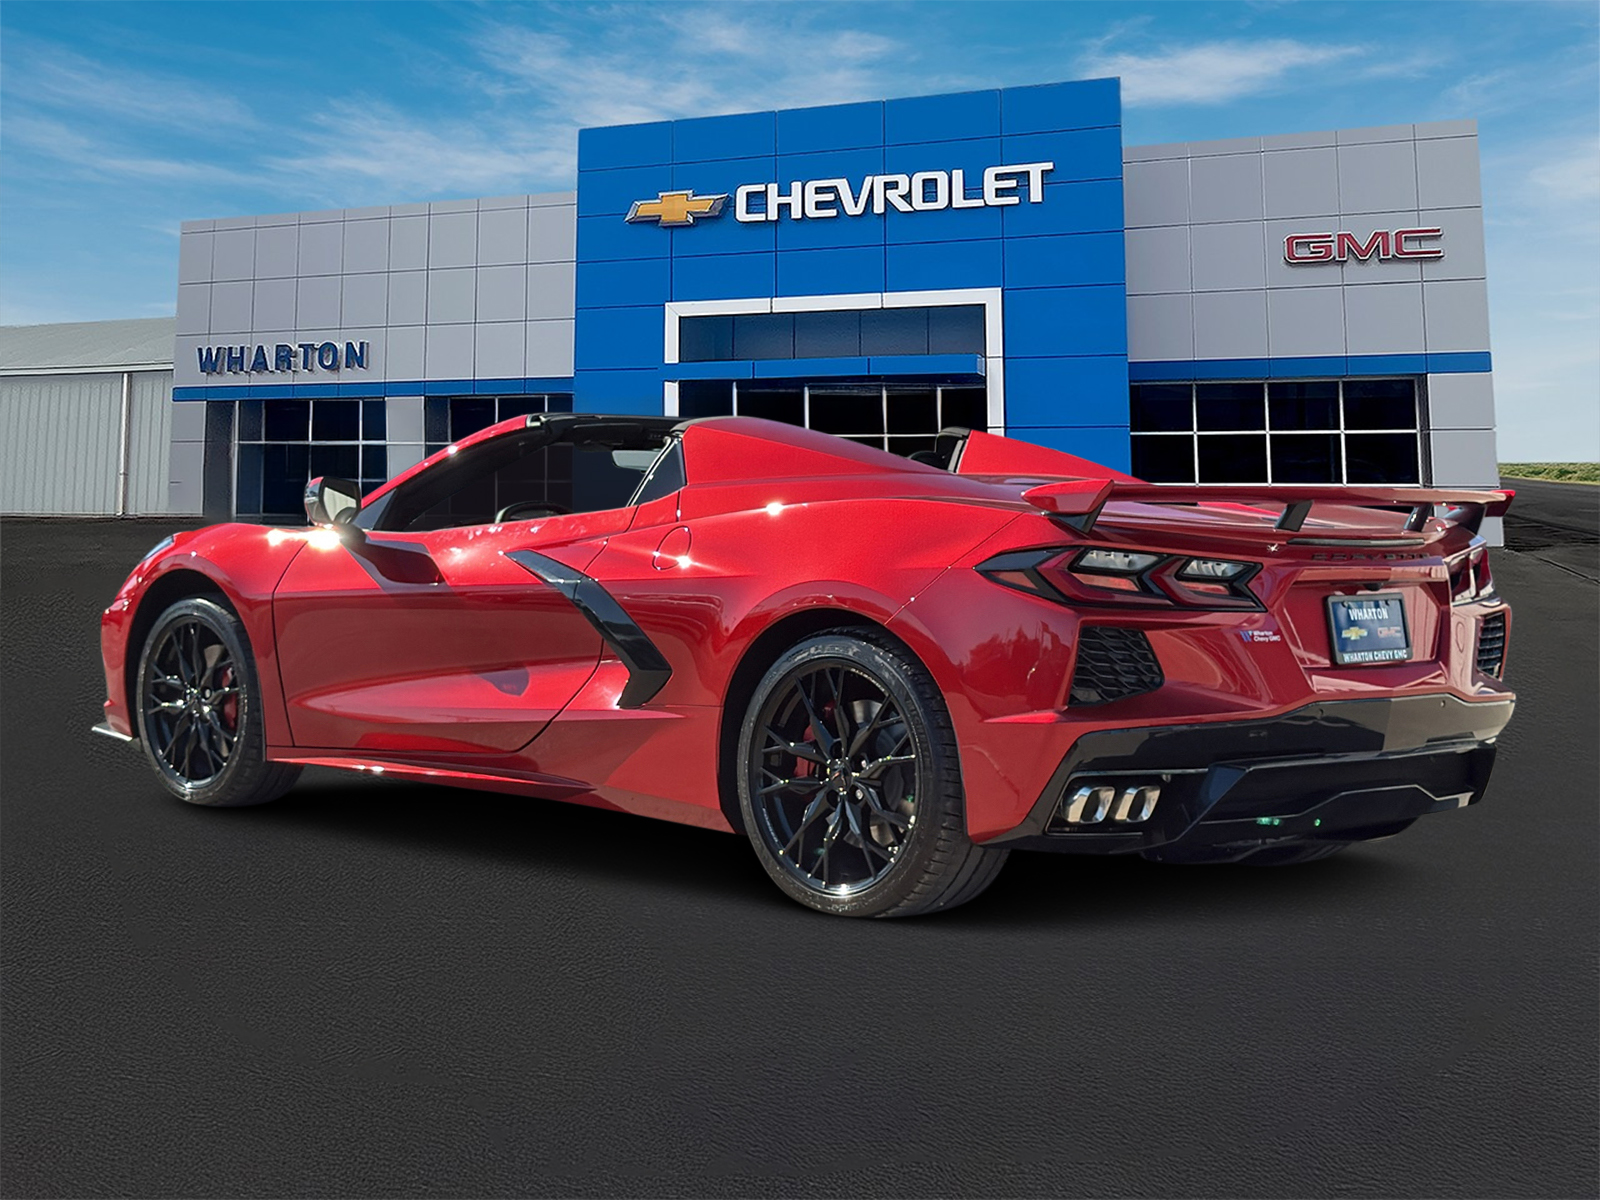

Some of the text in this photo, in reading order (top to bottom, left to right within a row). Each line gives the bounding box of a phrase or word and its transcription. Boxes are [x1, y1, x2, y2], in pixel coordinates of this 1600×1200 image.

[734, 161, 1054, 223] CHEVROLET
[1284, 226, 1445, 264] GMC
[196, 340, 370, 374] WHARTON
[1348, 607, 1389, 621] WHARTON
[1342, 649, 1408, 663] WHARTON CHEVY GMC
